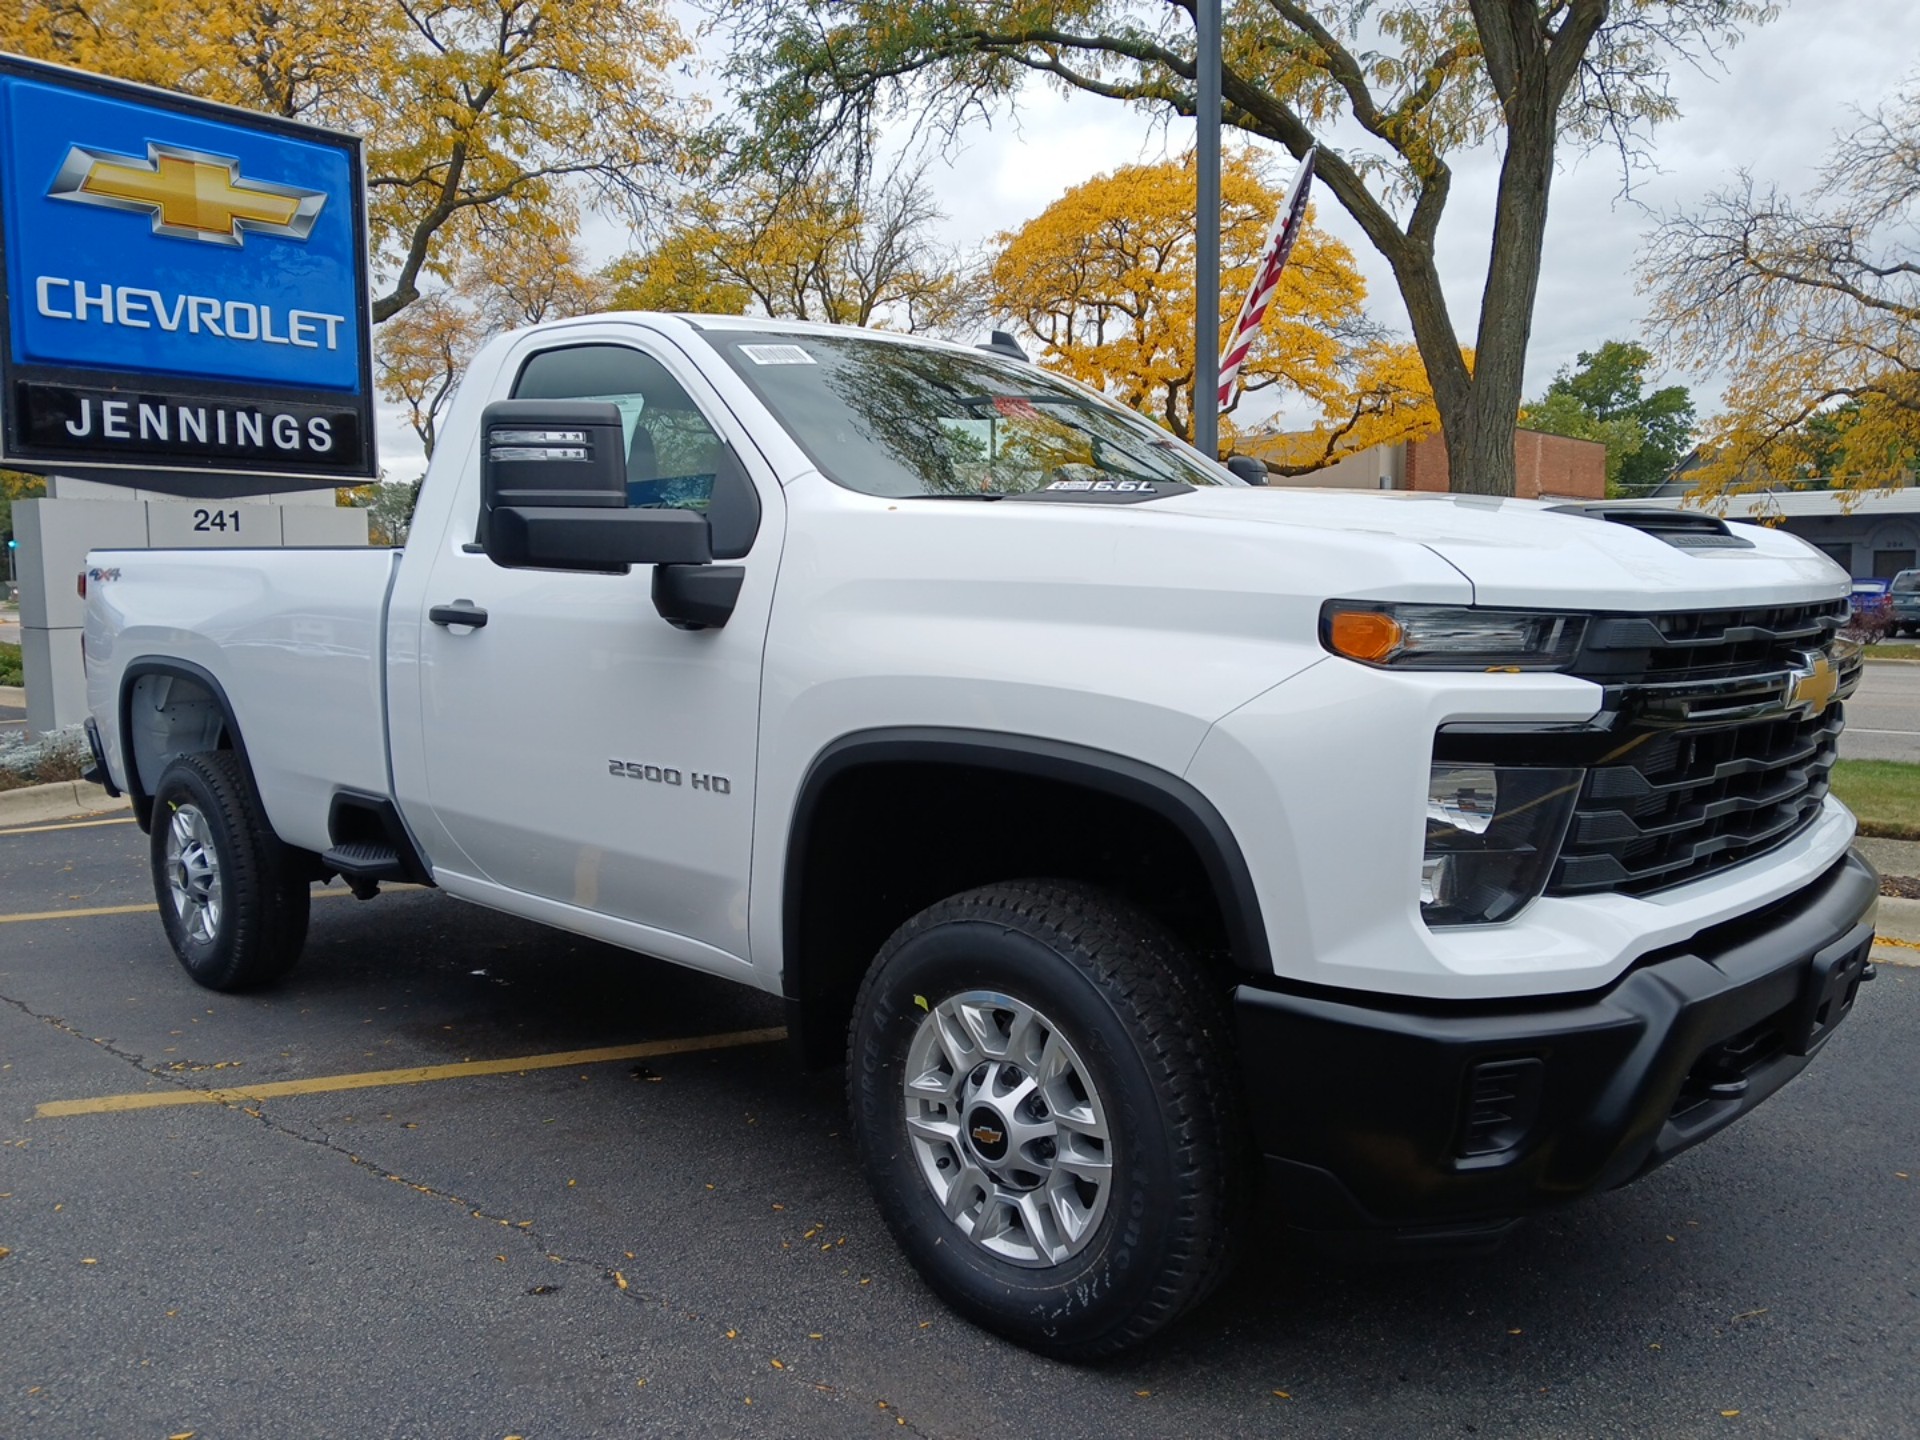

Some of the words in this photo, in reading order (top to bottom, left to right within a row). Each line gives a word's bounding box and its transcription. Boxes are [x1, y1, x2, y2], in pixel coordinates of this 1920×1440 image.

[36, 275, 345, 350] CHEVROLET
[65, 399, 333, 452] JENNINGS
[193, 509, 241, 532] 241
[608, 759, 682, 786] 2500
[691, 772, 731, 794] HD
